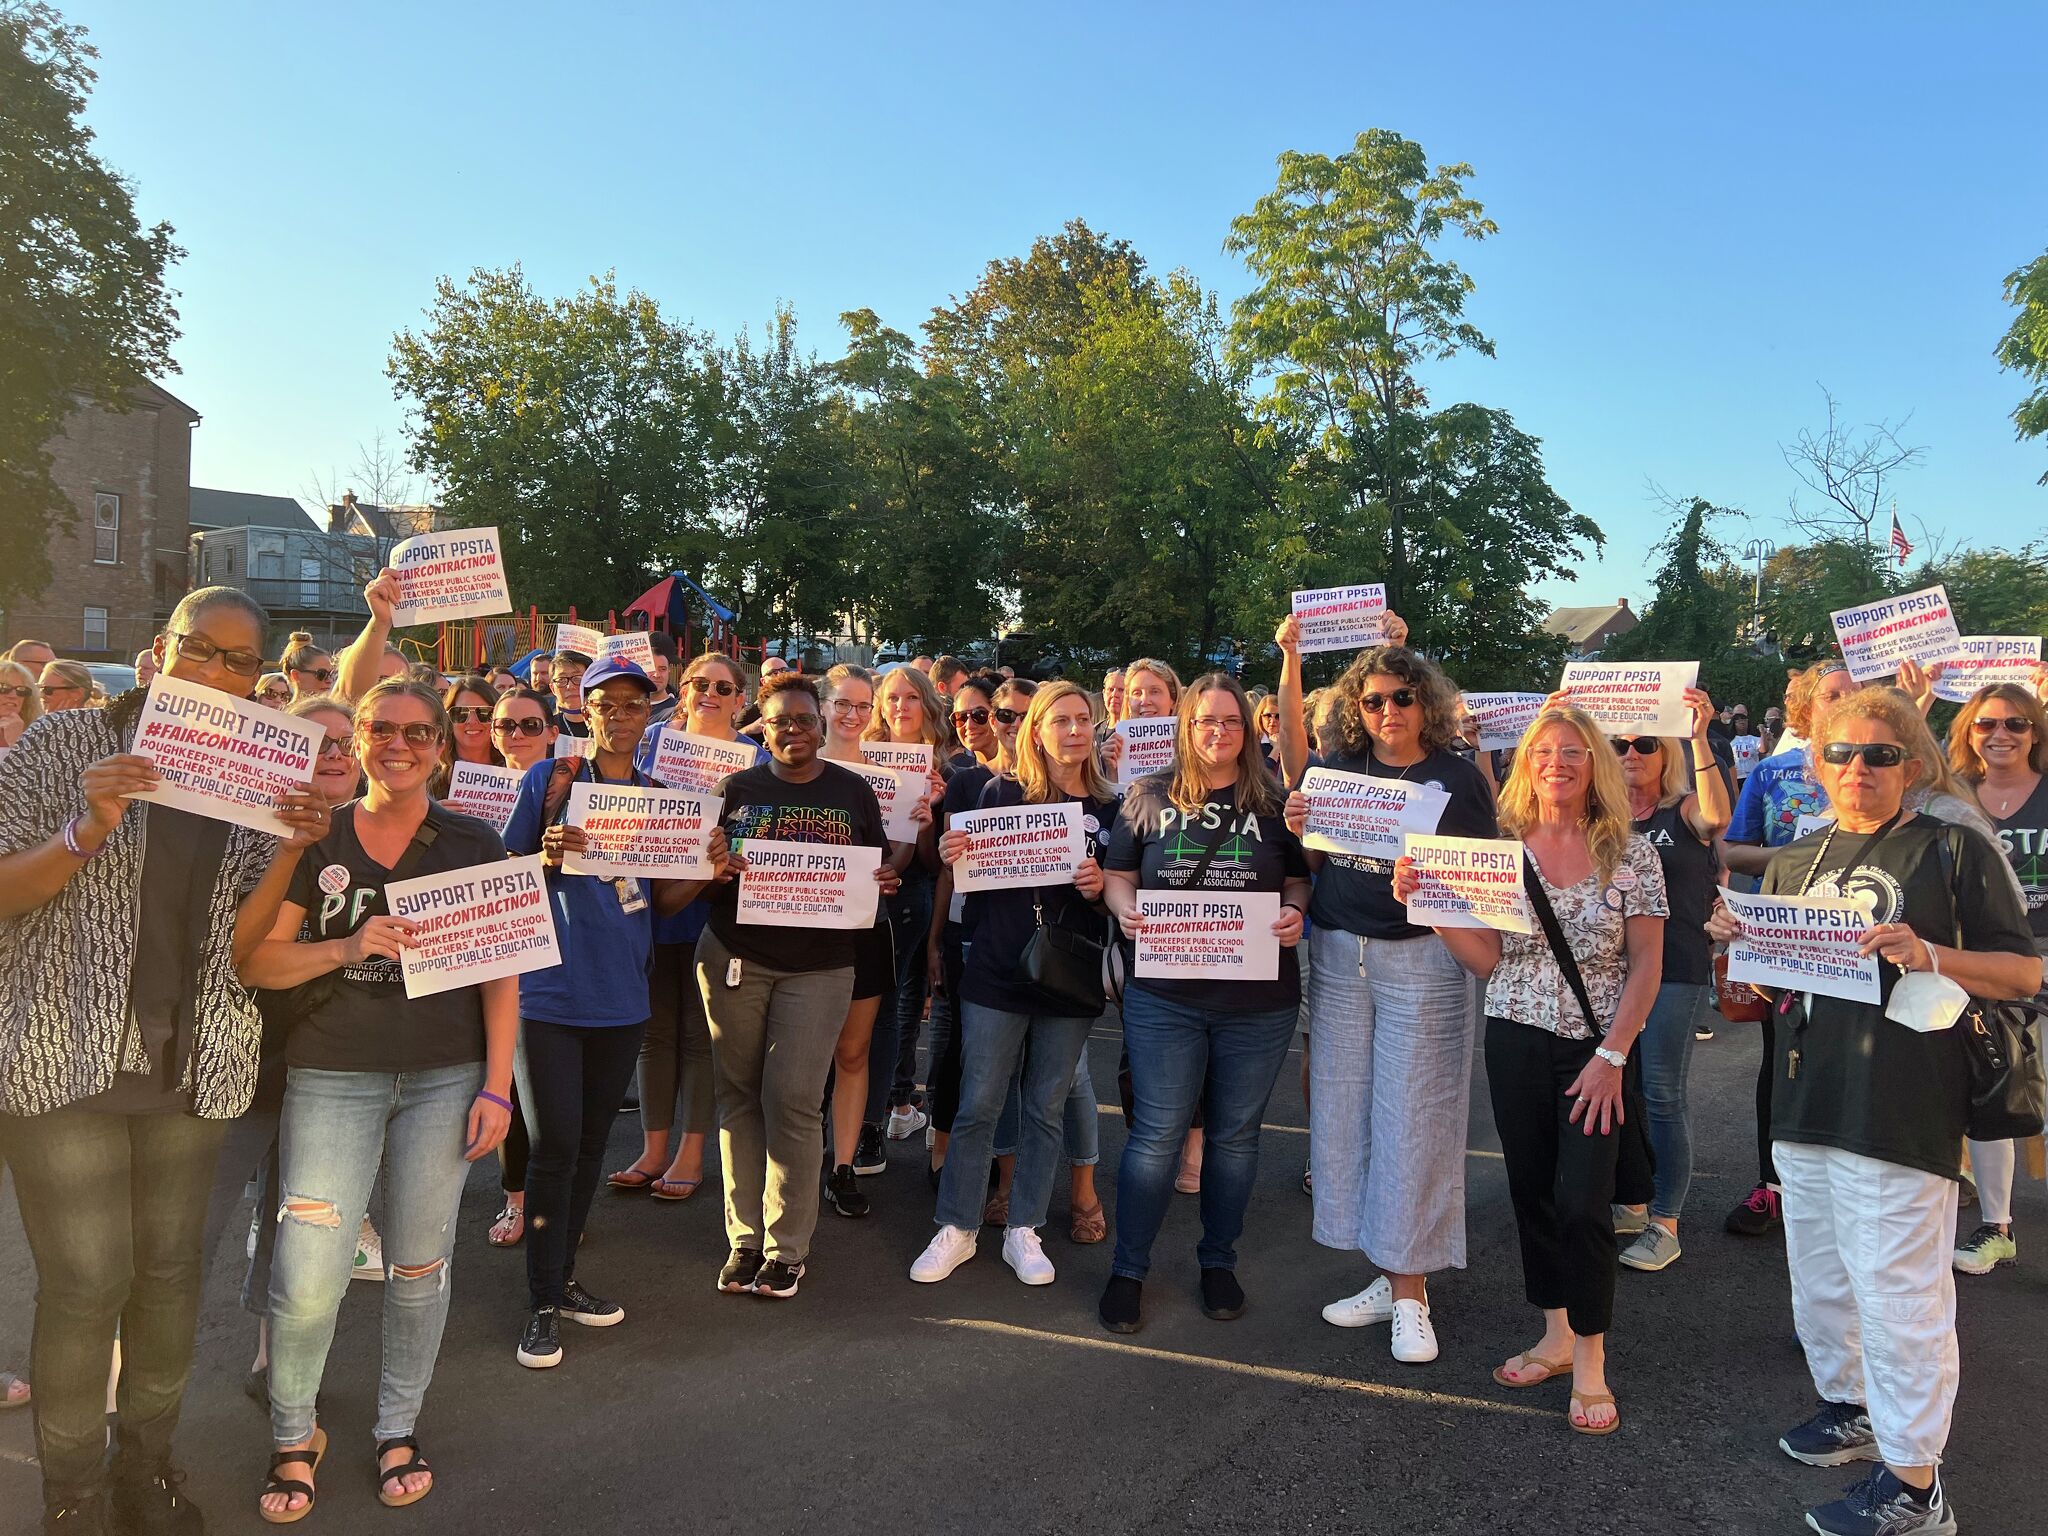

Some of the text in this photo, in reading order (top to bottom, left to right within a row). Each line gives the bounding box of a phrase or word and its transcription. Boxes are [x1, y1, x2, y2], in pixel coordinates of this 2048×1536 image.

[393, 539, 493, 566] SUPPORT PPSTA
[446, 572, 500, 585] PUBLIC SCHOOL
[445, 582, 491, 594] ASSOCIATION
[1296, 588, 1381, 603] SUPPORT PPSTA
[395, 599, 428, 610] SUPPORT
[432, 595, 458, 604] PUBLIC
[461, 589, 502, 600] EDUCATION
[1296, 598, 1382, 619] #FAIRCONTRACTNOW
[1836, 593, 1943, 629] SUPPORT PPSTA
[1339, 623, 1376, 632] ASSOCIATION
[1843, 607, 1948, 647] #FAIRCONTRACTNOW
[599, 641, 624, 651] SUPPORT
[626, 638, 647, 648] PPSTA
[1298, 632, 1386, 647] SUPPORT PUBLIC EDUCATION
[1845, 625, 1955, 657] POUGHKEEPSIE PUBLIC SCHOOL
[1898, 636, 1946, 652] ASSOCIATION
[1997, 642, 2036, 654] PPSTA
[1852, 663, 1887, 677] SUPPORT
[1916, 644, 1960, 662] EDUCATION
[1569, 671, 1661, 682] SUPPORT PPSTA
[1567, 683, 1661, 695] #FAIRCONTRACTNOW
[1467, 697, 1514, 710] SUPPORT
[155, 692, 310, 756] SUPPORT PPSTA
[1514, 714, 1533, 722] PUBLIC
[1620, 712, 1658, 721] EDUCATION
[1129, 724, 1176, 738] SUPPORT
[145, 722, 309, 770] #FAIRCONTRACTNOW
[663, 738, 745, 766] SUPPORT PPSTA
[140, 739, 264, 778] POUGHKEEPSIE PUBLIC
[896, 752, 927, 764] PPSTA
[1129, 752, 1172, 760] POUGHKEEPSIE
[458, 771, 513, 790] SUPPORT
[656, 765, 719, 783] POUGHKEEPSIE PUBLIC
[191, 775, 233, 796] PUBLIC
[219, 770, 288, 796] ASSOCIATION
[1307, 777, 1365, 795] SUPPORT
[1366, 786, 1408, 802] PPSTA
[588, 794, 701, 816] SUPPORT PPSTA
[778, 806, 850, 823] KIND
[1351, 814, 1400, 827] PUBLIC SCHOOL
[585, 817, 702, 830] #FAIRCONTRACTNOW
[777, 818, 852, 836] KIND
[965, 816, 1022, 835] SUPPORT
[1026, 812, 1066, 829] PPSTA
[1348, 822, 1390, 833] ASSOCIATION
[584, 833, 642, 843] POUGHKEEPSIE
[672, 838, 700, 846] SCHOOL
[967, 827, 1068, 852] #FAIRCONTRACTNOW
[1305, 825, 1334, 836] SUPPORT
[1335, 829, 1359, 839] PUBLIC
[1361, 831, 1399, 845] EDUCATION
[639, 845, 689, 854] ASSOCIATION
[967, 846, 1071, 861] POUGHKEEPSIE PUBLIC SCHOOL
[581, 850, 618, 861] SUPPORT
[621, 853, 651, 863] PUBLIC
[653, 854, 698, 865] EDUCATION
[747, 851, 846, 871] SUPPORT PPSTA
[1016, 855, 1061, 865] ASSOCIATION
[1410, 846, 1516, 871] SUPPORT PPSTA
[968, 867, 1001, 878] SUPPORT
[1003, 865, 1029, 876] PUBLIC
[1030, 862, 1071, 873] EDUCATION
[1206, 870, 1258, 881] PUBLIC SCHOOL
[1353, 862, 1392, 875] ASSOCIATION
[745, 872, 846, 883] #FAIRCONTRACTNOW
[1203, 878, 1245, 888] ASSOCIATION
[396, 882, 475, 916] SUPPORT
[481, 871, 538, 899] PPSTA
[743, 884, 845, 896] POUGHKEEPSIE PUBLIC SCHOOL
[1467, 886, 1521, 899] PUBLIC SCHOOL
[742, 900, 774, 909] SUPPORT
[777, 902, 802, 911] PUBLIC
[804, 903, 843, 913] EDUCATION
[792, 895, 835, 903] ASSOCIATION
[1465, 895, 1512, 905] ASSOCIATION
[1142, 902, 1243, 919] SUPPORT PPSTA
[1412, 899, 1448, 909] SUPPORT
[1451, 901, 1478, 911] PUBLIC
[1481, 905, 1524, 917] EDUCATION
[1727, 899, 1865, 928] SUPPORT PPSTA
[476, 914, 547, 936] PUBLIC SCHOOL
[1140, 920, 1244, 934] #FAIRCONTRACTNOW
[474, 927, 535, 947] ASSOCIATION
[1140, 937, 1191, 945] POUGHKEEPSIE
[1218, 938, 1244, 946] SCHOOL
[408, 959, 453, 975] SUPPORT
[457, 948, 492, 965] PUBLIC
[495, 935, 550, 955] EDUCATION
[1189, 946, 1234, 954] ASSOCIATION
[1800, 945, 1831, 954] PUBLIC
[1140, 953, 1243, 964] SUPPORT PUBLIC EDUCATION
[1735, 950, 1778, 965] SUPPORT
[1781, 957, 1814, 971] PUBLIC
[1818, 964, 1872, 982] EDUCATION
[1798, 952, 1858, 968] ASSOCIATION
[343, 969, 387, 982] TEACHERS'
